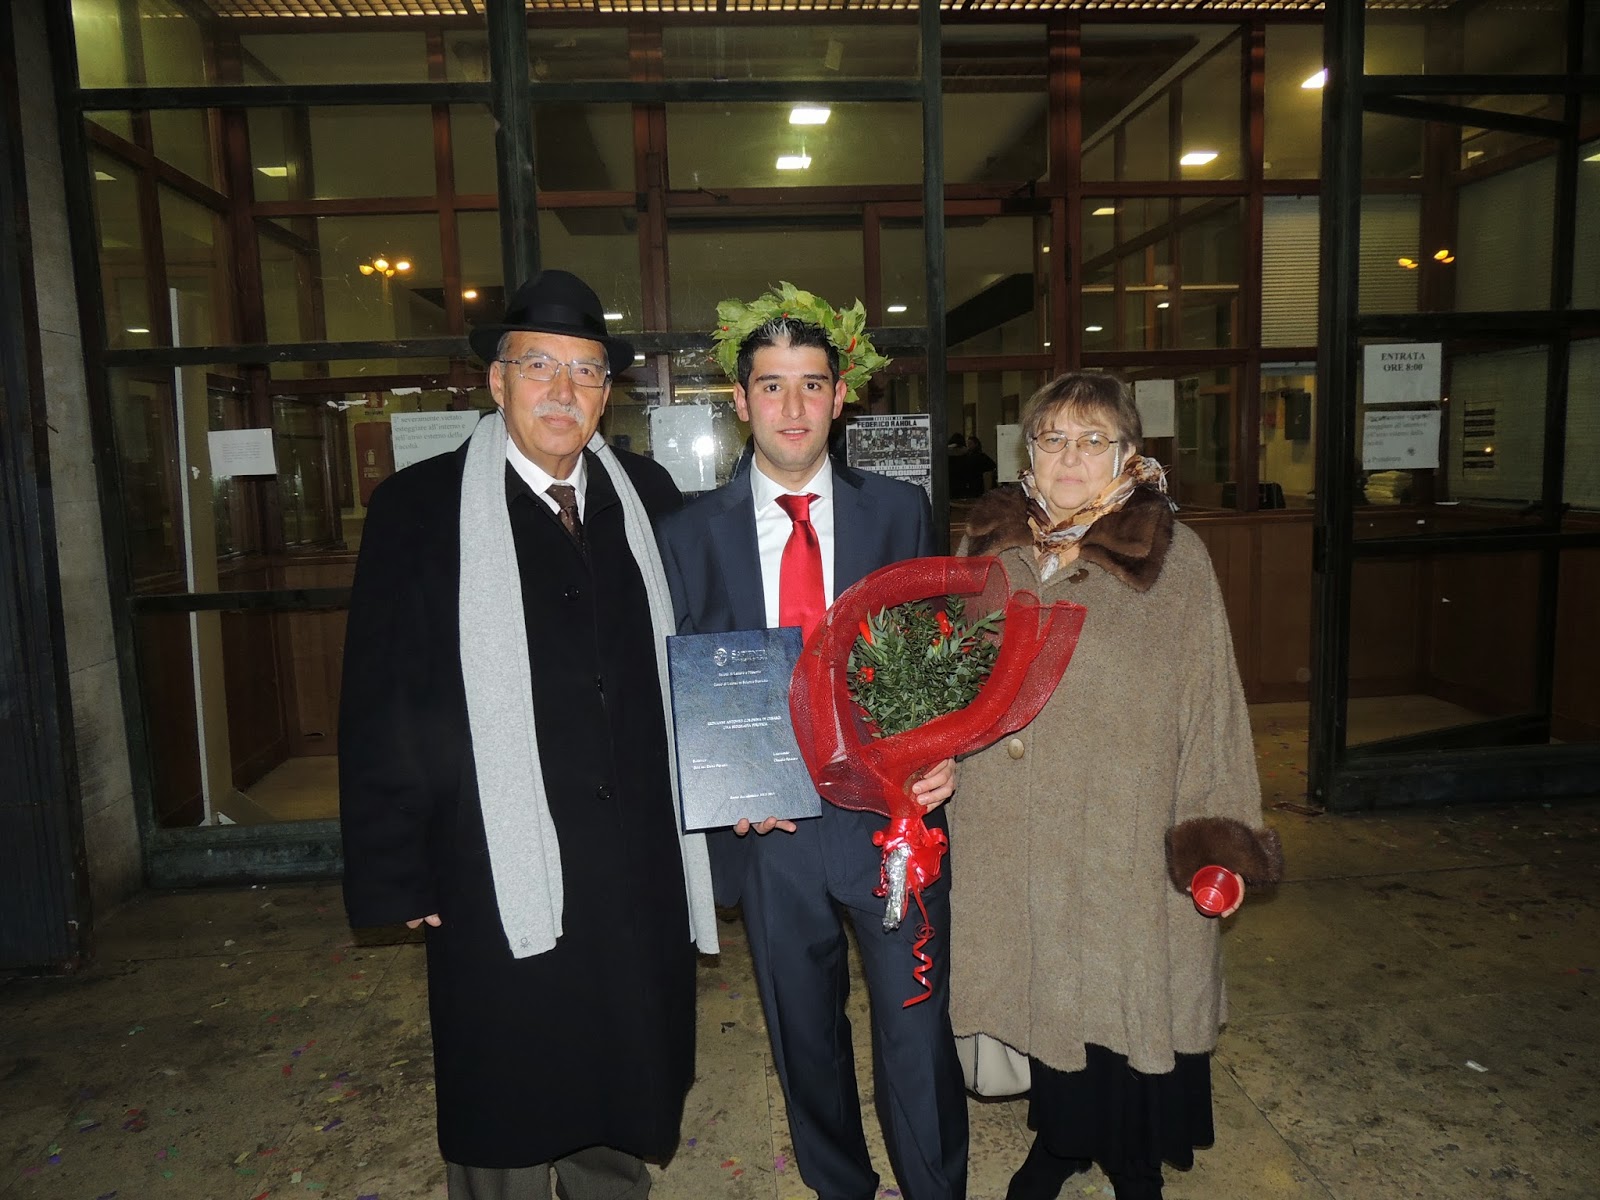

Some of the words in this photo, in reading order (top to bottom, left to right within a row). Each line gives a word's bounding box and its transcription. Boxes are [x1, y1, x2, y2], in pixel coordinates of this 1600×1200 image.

[1381, 352, 1426, 361] ENTRATA
[1383, 363, 1404, 372] ORE
[1405, 363, 1424, 372] 8:00
[400, 415, 440, 423] severamente
[857, 420, 890, 428] FEDERICO
[890, 420, 918, 428] RAHOLA
